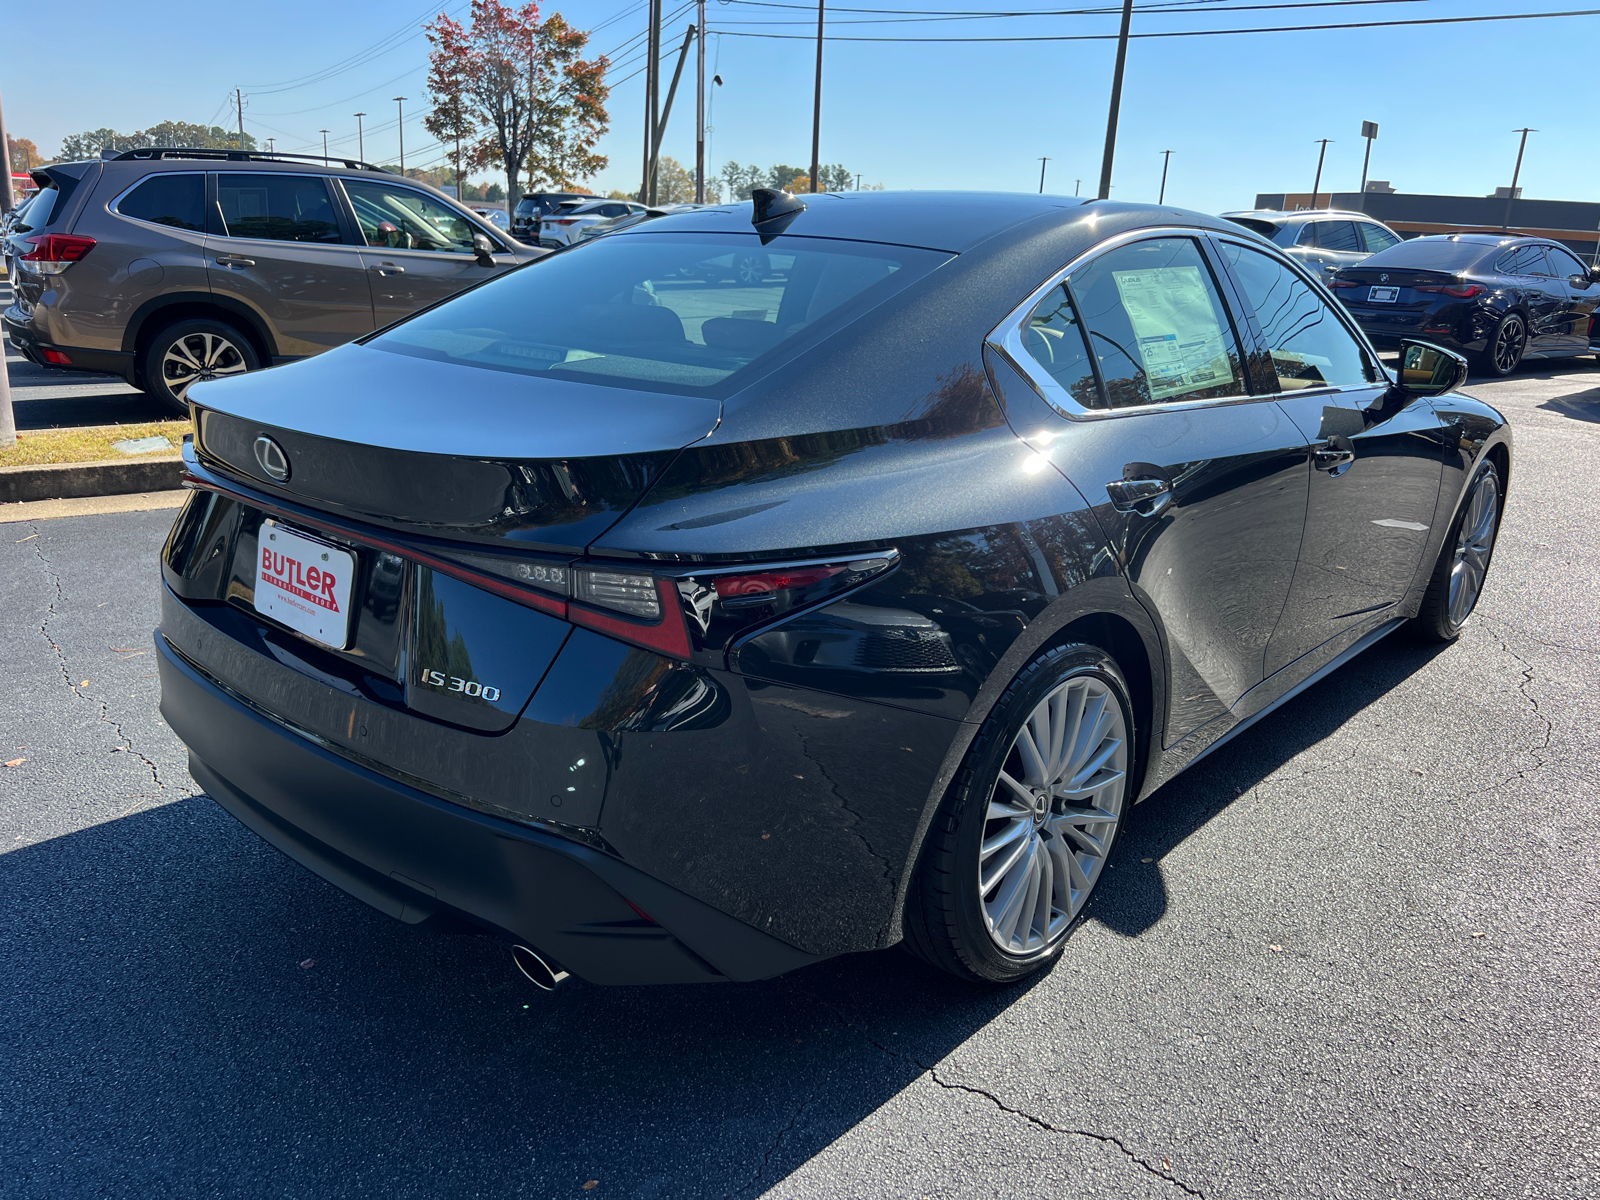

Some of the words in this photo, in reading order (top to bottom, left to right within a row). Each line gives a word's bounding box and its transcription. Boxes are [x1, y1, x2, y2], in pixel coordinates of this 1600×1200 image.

[310, 594, 337, 610] GROUP
[421, 668, 446, 687] IS
[447, 676, 501, 702] 300
